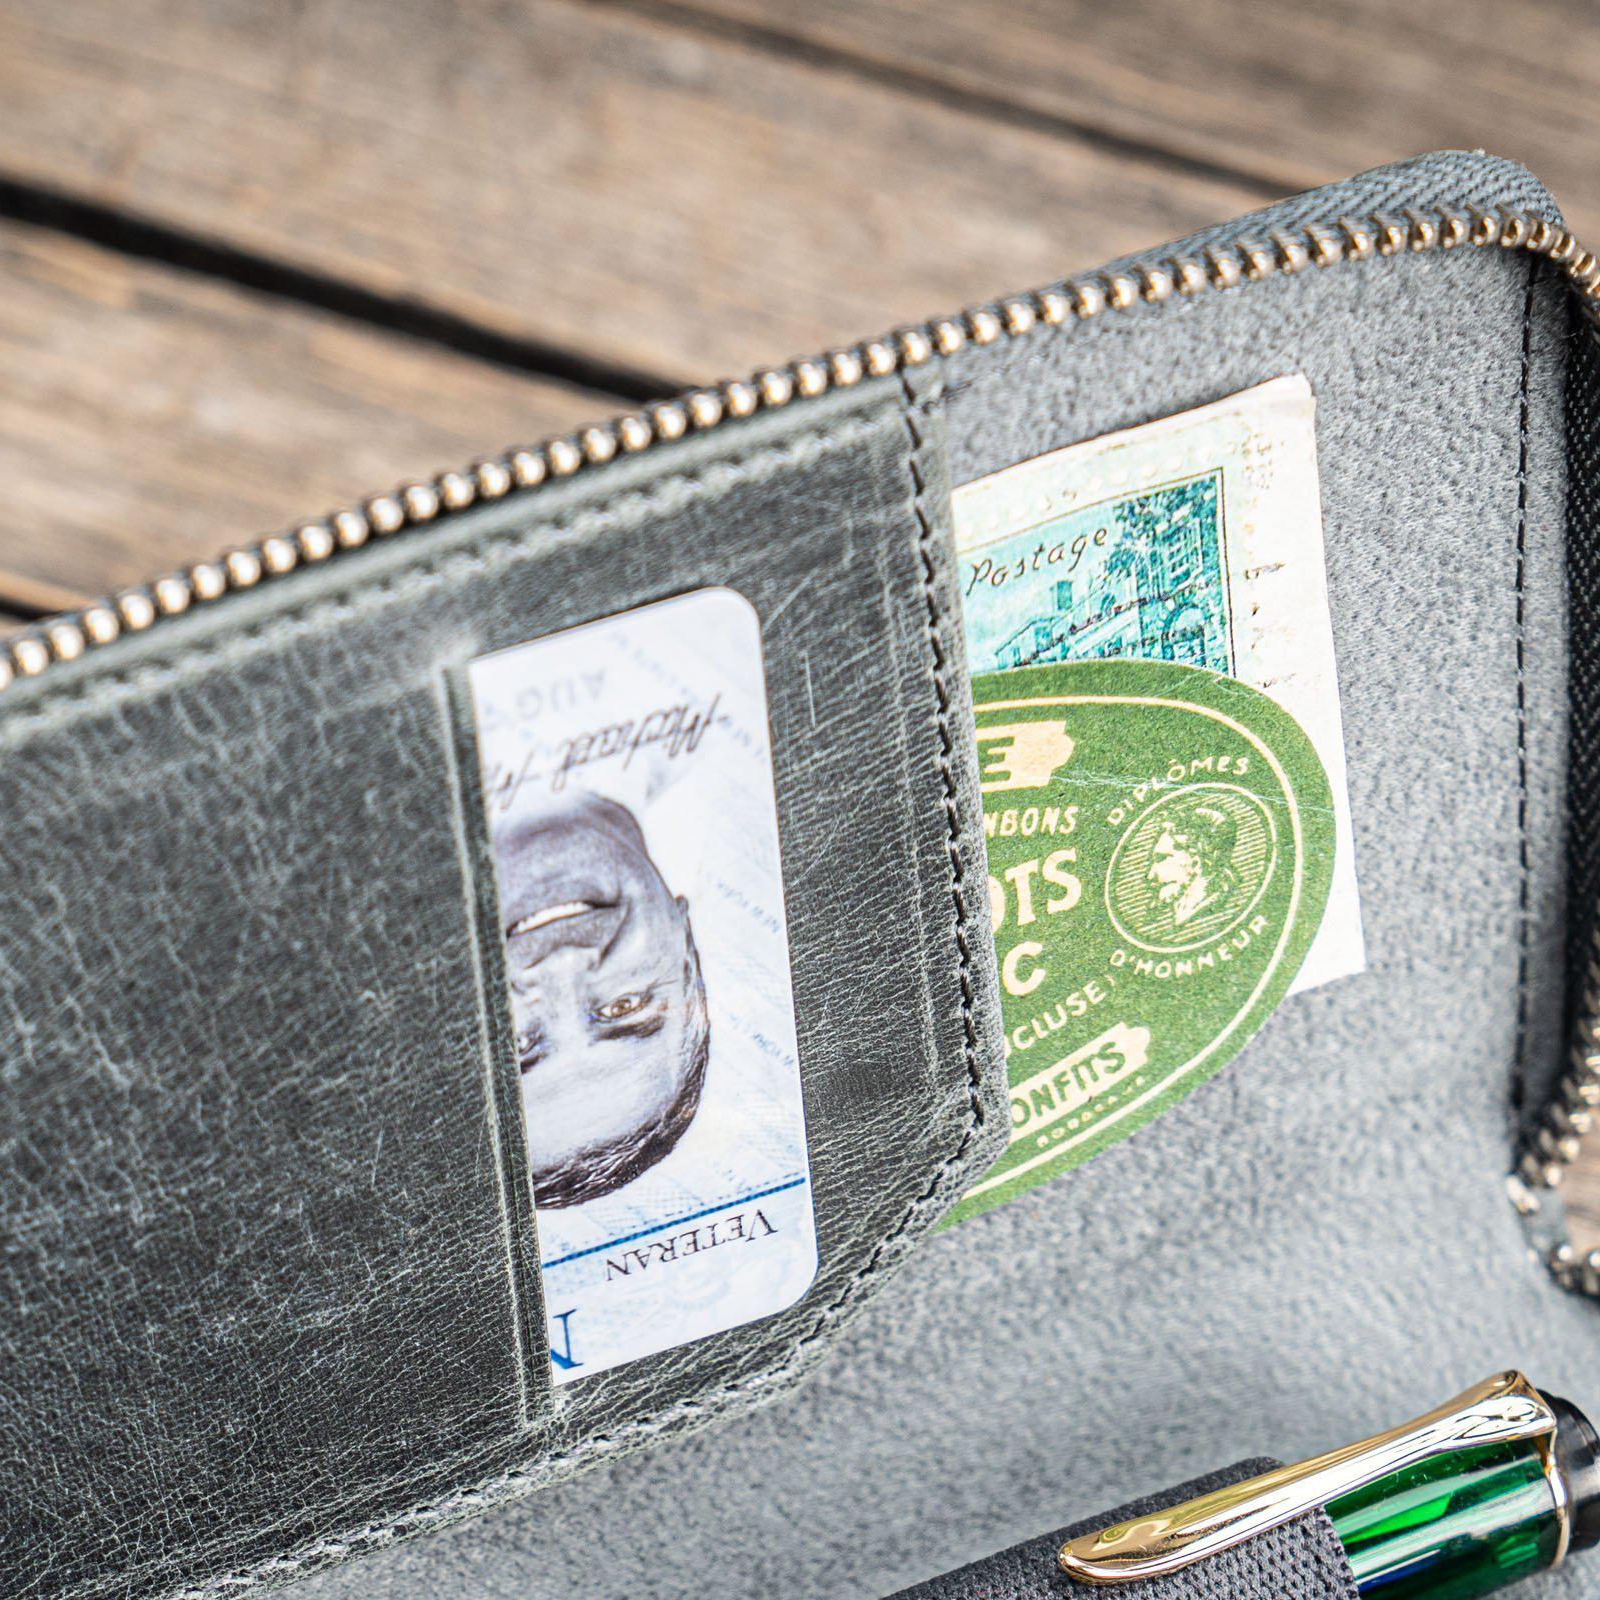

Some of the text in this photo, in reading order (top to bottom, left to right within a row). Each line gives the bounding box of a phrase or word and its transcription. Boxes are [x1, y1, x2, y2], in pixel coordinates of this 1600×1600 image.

[964, 526, 1108, 597] Postage
[1106, 756, 1249, 826] DIPLÔMES
[1002, 941, 1047, 996] C
[1110, 914, 1269, 979] D'HONNEUR
[1010, 1041, 1127, 1129] ONFITS
[605, 1208, 779, 1282] VETERAN
